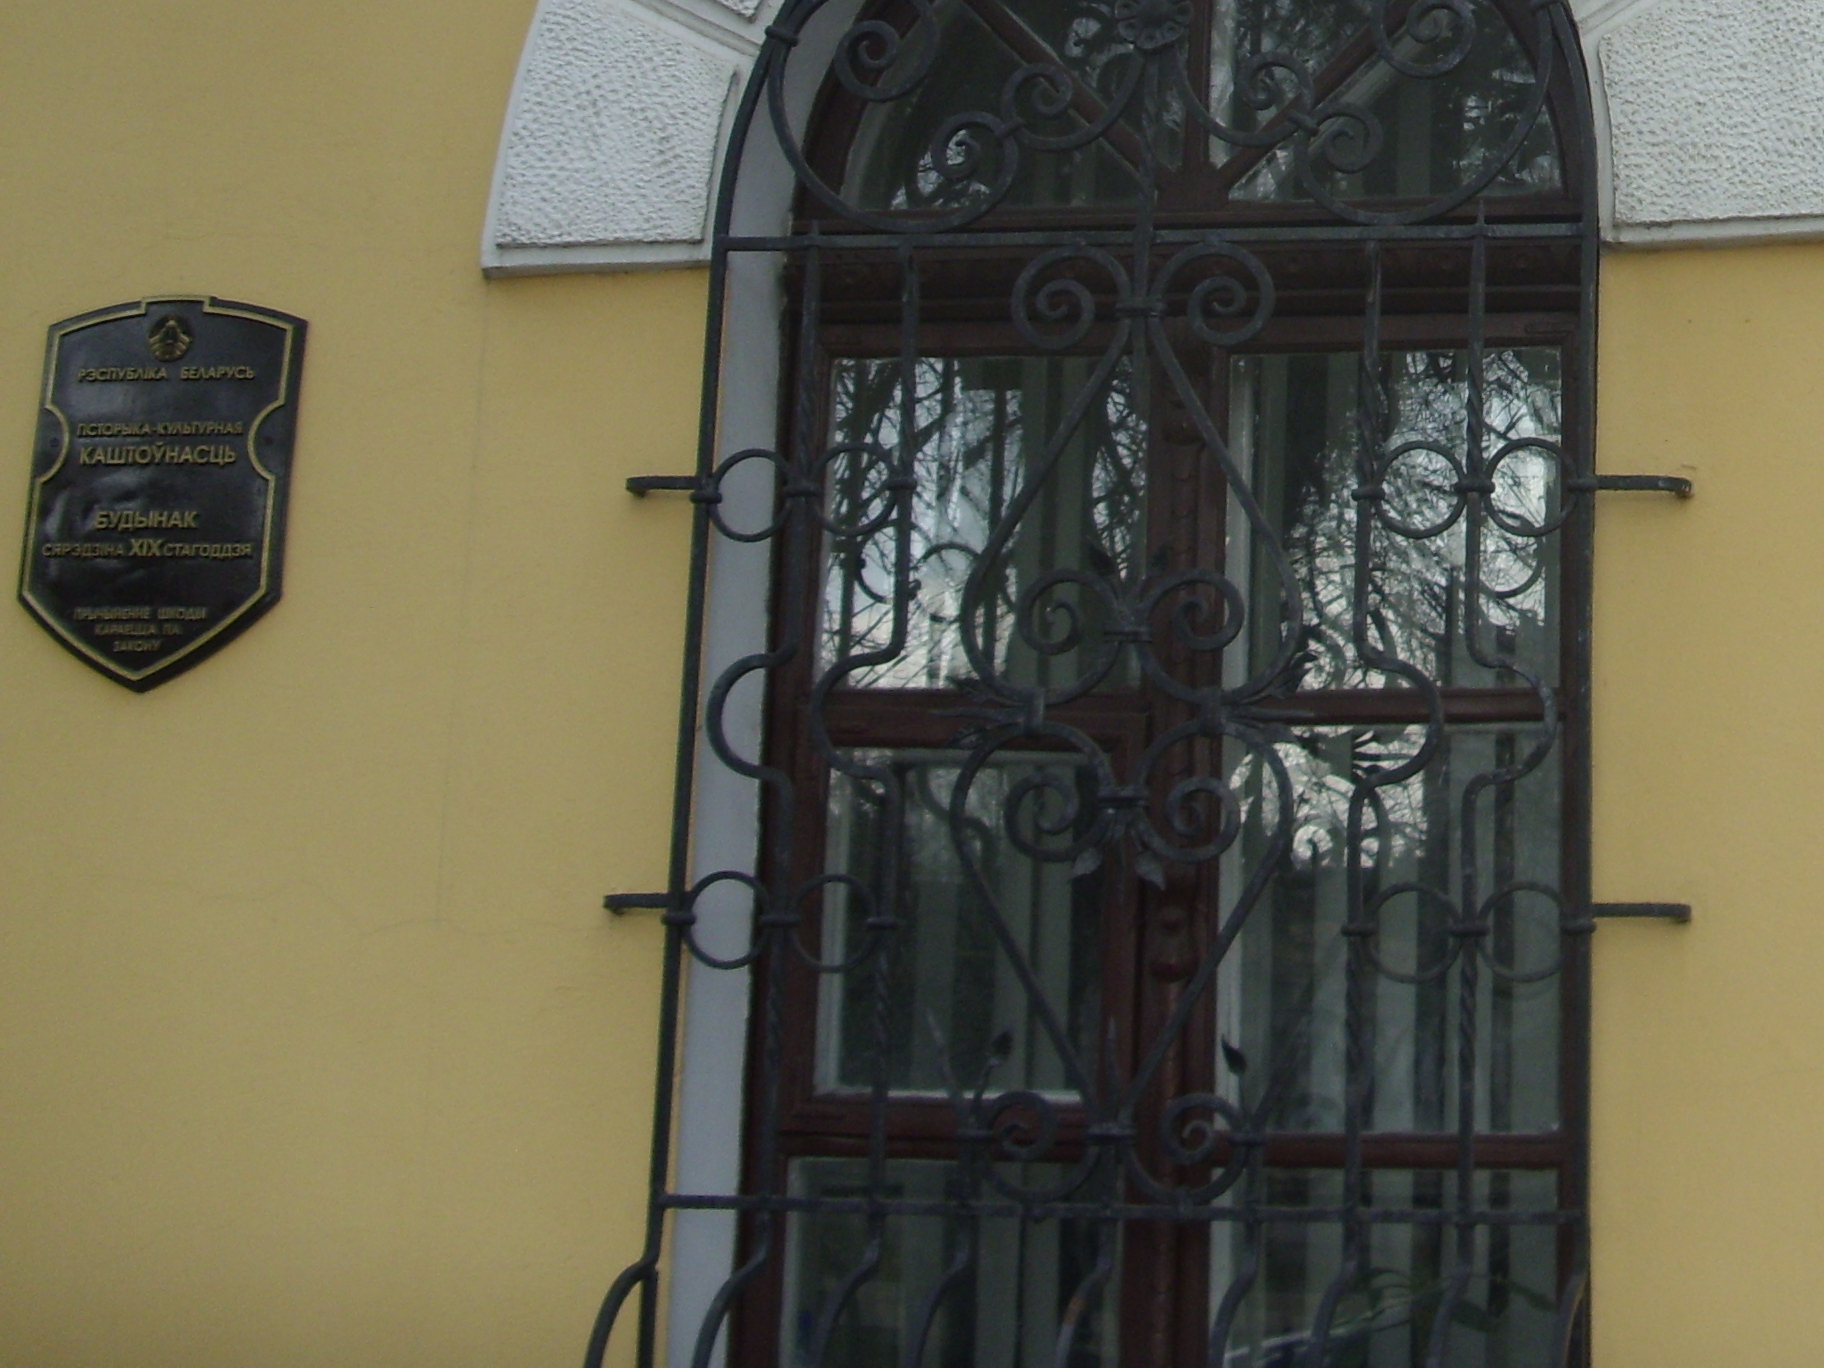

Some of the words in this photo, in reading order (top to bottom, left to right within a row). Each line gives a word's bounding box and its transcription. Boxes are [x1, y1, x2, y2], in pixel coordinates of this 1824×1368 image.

[78, 367, 168, 382] РЭСПУБЛІКА
[180, 366, 256, 380] БЕЛАРУСЬ
[79, 442, 238, 466] КАШТОЎНАСЦЬ
[95, 510, 199, 532] БУДЫНАК
[42, 543, 124, 558] СЯРЭДЗІНА
[164, 543, 252, 559] СТАГОДДЗЯ
